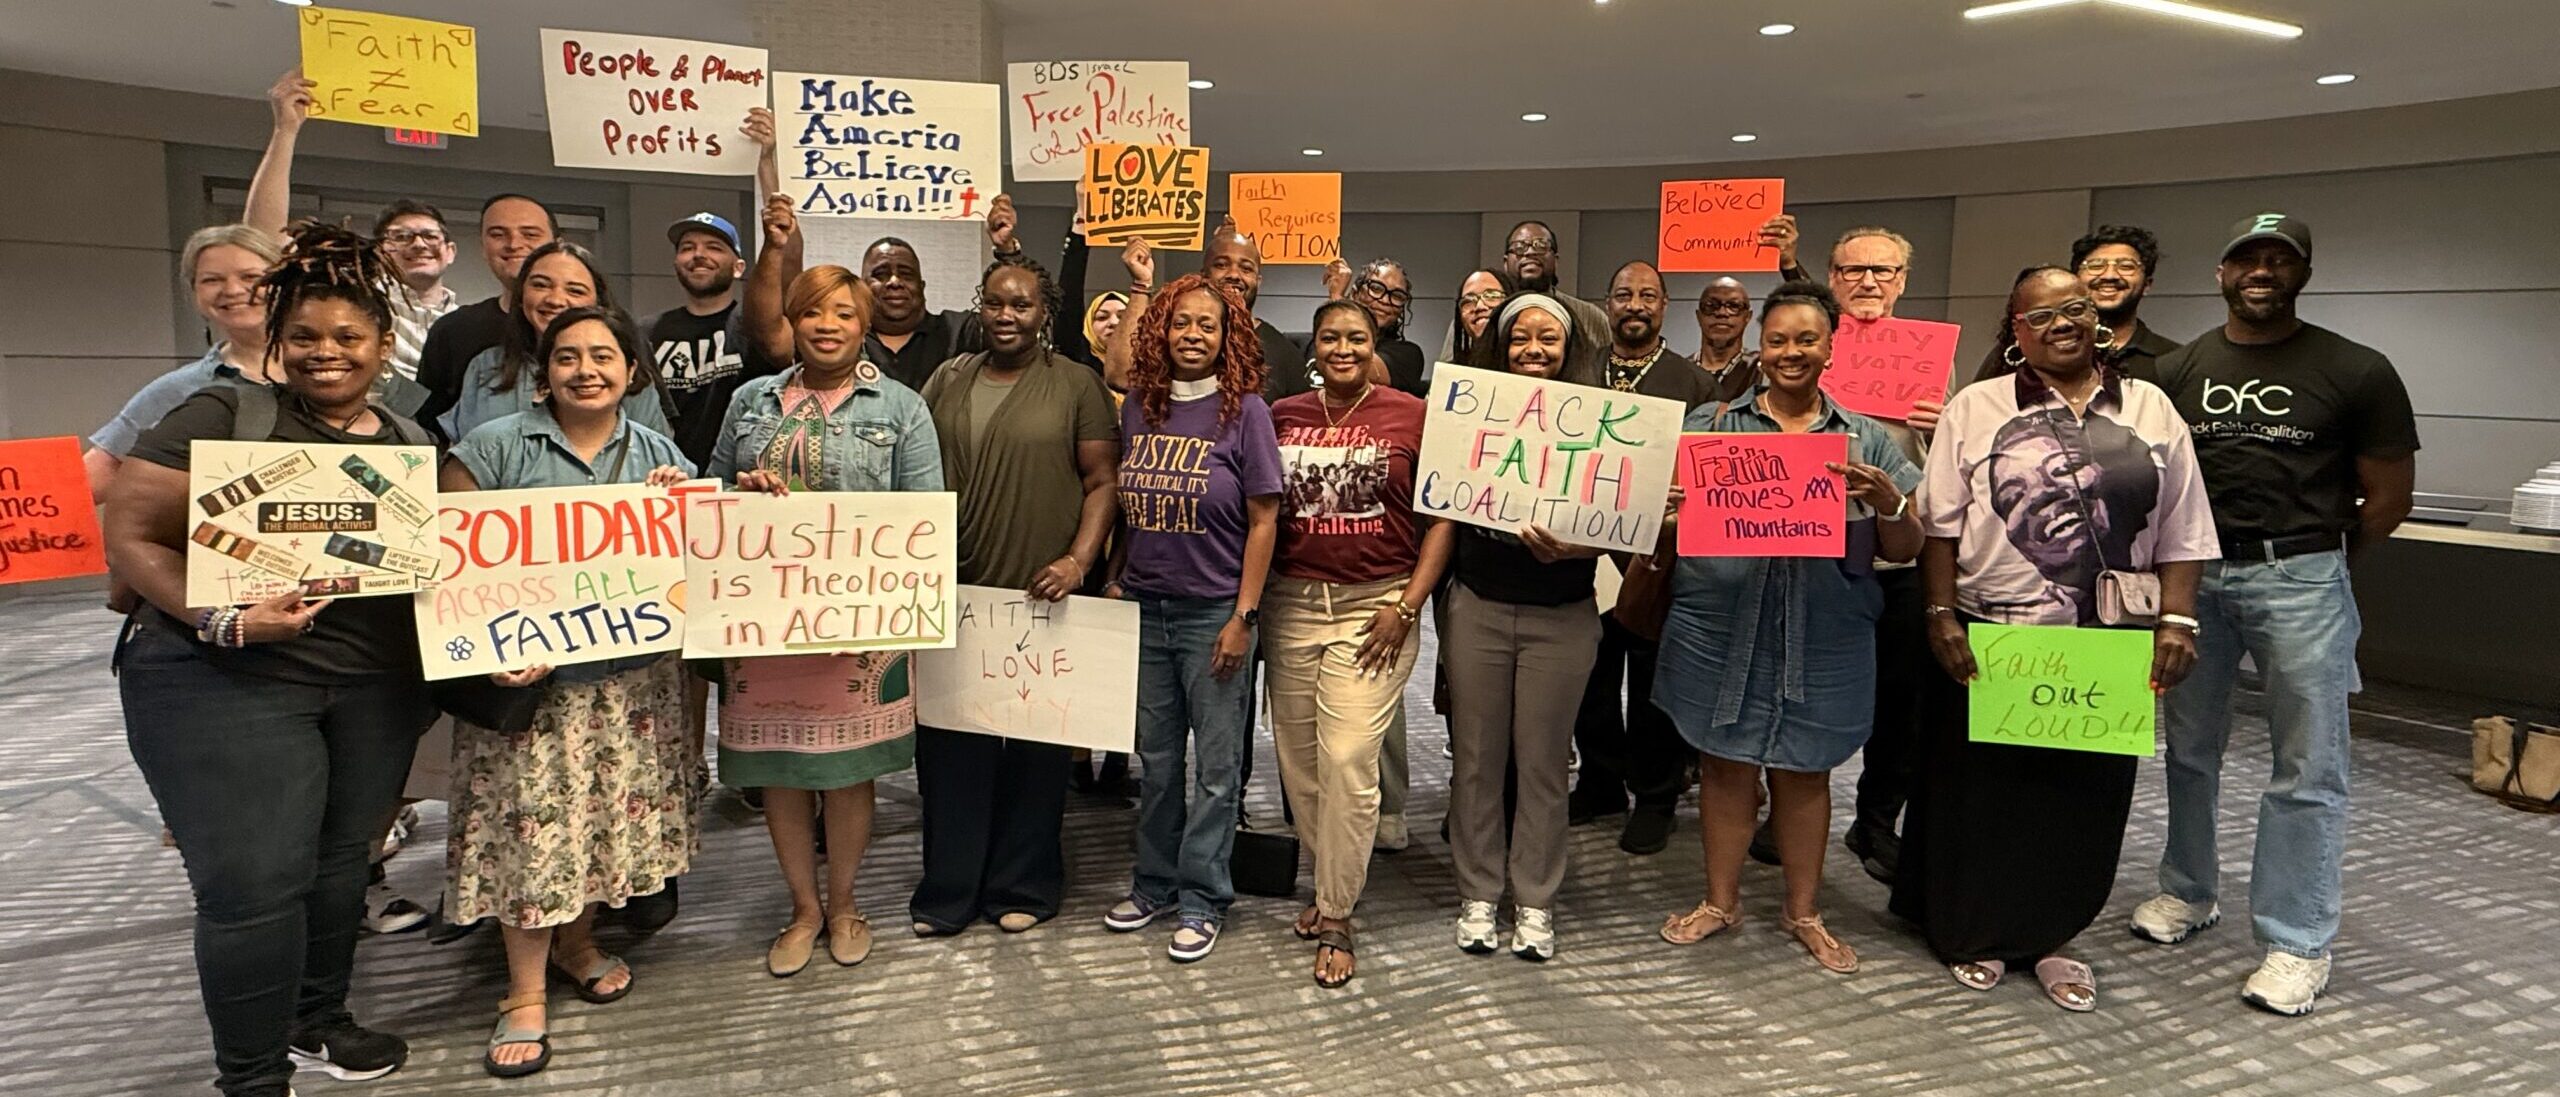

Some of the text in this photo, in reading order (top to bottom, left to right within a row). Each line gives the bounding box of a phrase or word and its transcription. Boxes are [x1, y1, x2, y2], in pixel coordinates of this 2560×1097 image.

[327, 19, 457, 69] Faith
[562, 40, 764, 87] People & Planet
[1034, 61, 1080, 84] BDS
[331, 87, 434, 117] Fear
[628, 87, 699, 115] OVER
[800, 78, 916, 116] Make
[1022, 71, 1190, 135] Free Palestine
[602, 118, 722, 156] Profits
[1092, 145, 1201, 188] LOVE
[801, 182, 953, 215] Again!!!
[1236, 177, 1287, 200] Faith
[1665, 185, 1765, 214] Beloved
[1700, 182, 1733, 192] The
[1085, 186, 1204, 223] LIBERATES
[1258, 206, 1336, 233] Requires
[2251, 213, 2286, 233] E
[1850, 353, 1935, 374] VOTE
[2202, 378, 2293, 415] bfc
[1445, 379, 1646, 448] BLACK
[2212, 421, 2248, 433] Faith
[2251, 423, 2314, 440] Coalition
[259, 456, 301, 480] CHALLENGED
[1121, 434, 1215, 475] JUSTICE
[1470, 428, 1633, 511] FAITH
[1688, 440, 1790, 488] Faith
[263, 467, 298, 486] INJUSTICE
[1134, 472, 1184, 491] POLITICAL
[269, 504, 363, 521] JESUS:
[1421, 470, 1641, 546] COALITION
[1707, 486, 1794, 510] moves
[264, 521, 372, 531] THE ORIGINAL ACTIVIST
[689, 498, 938, 561] Justice
[1307, 516, 1384, 537] Talking
[386, 559, 429, 574] THE OUTCAST
[364, 579, 410, 588] TAUGHT LOVE
[436, 567, 659, 625] ACROSS ALL
[711, 563, 944, 612] is Theology
[720, 600, 946, 647] in ACTION
[958, 601, 1052, 629] AITH
[487, 601, 672, 664] FAITHS
[981, 648, 1074, 679] LOVE
[1984, 630, 2073, 683] Faith
[1995, 703, 2145, 745] LOUD!!
